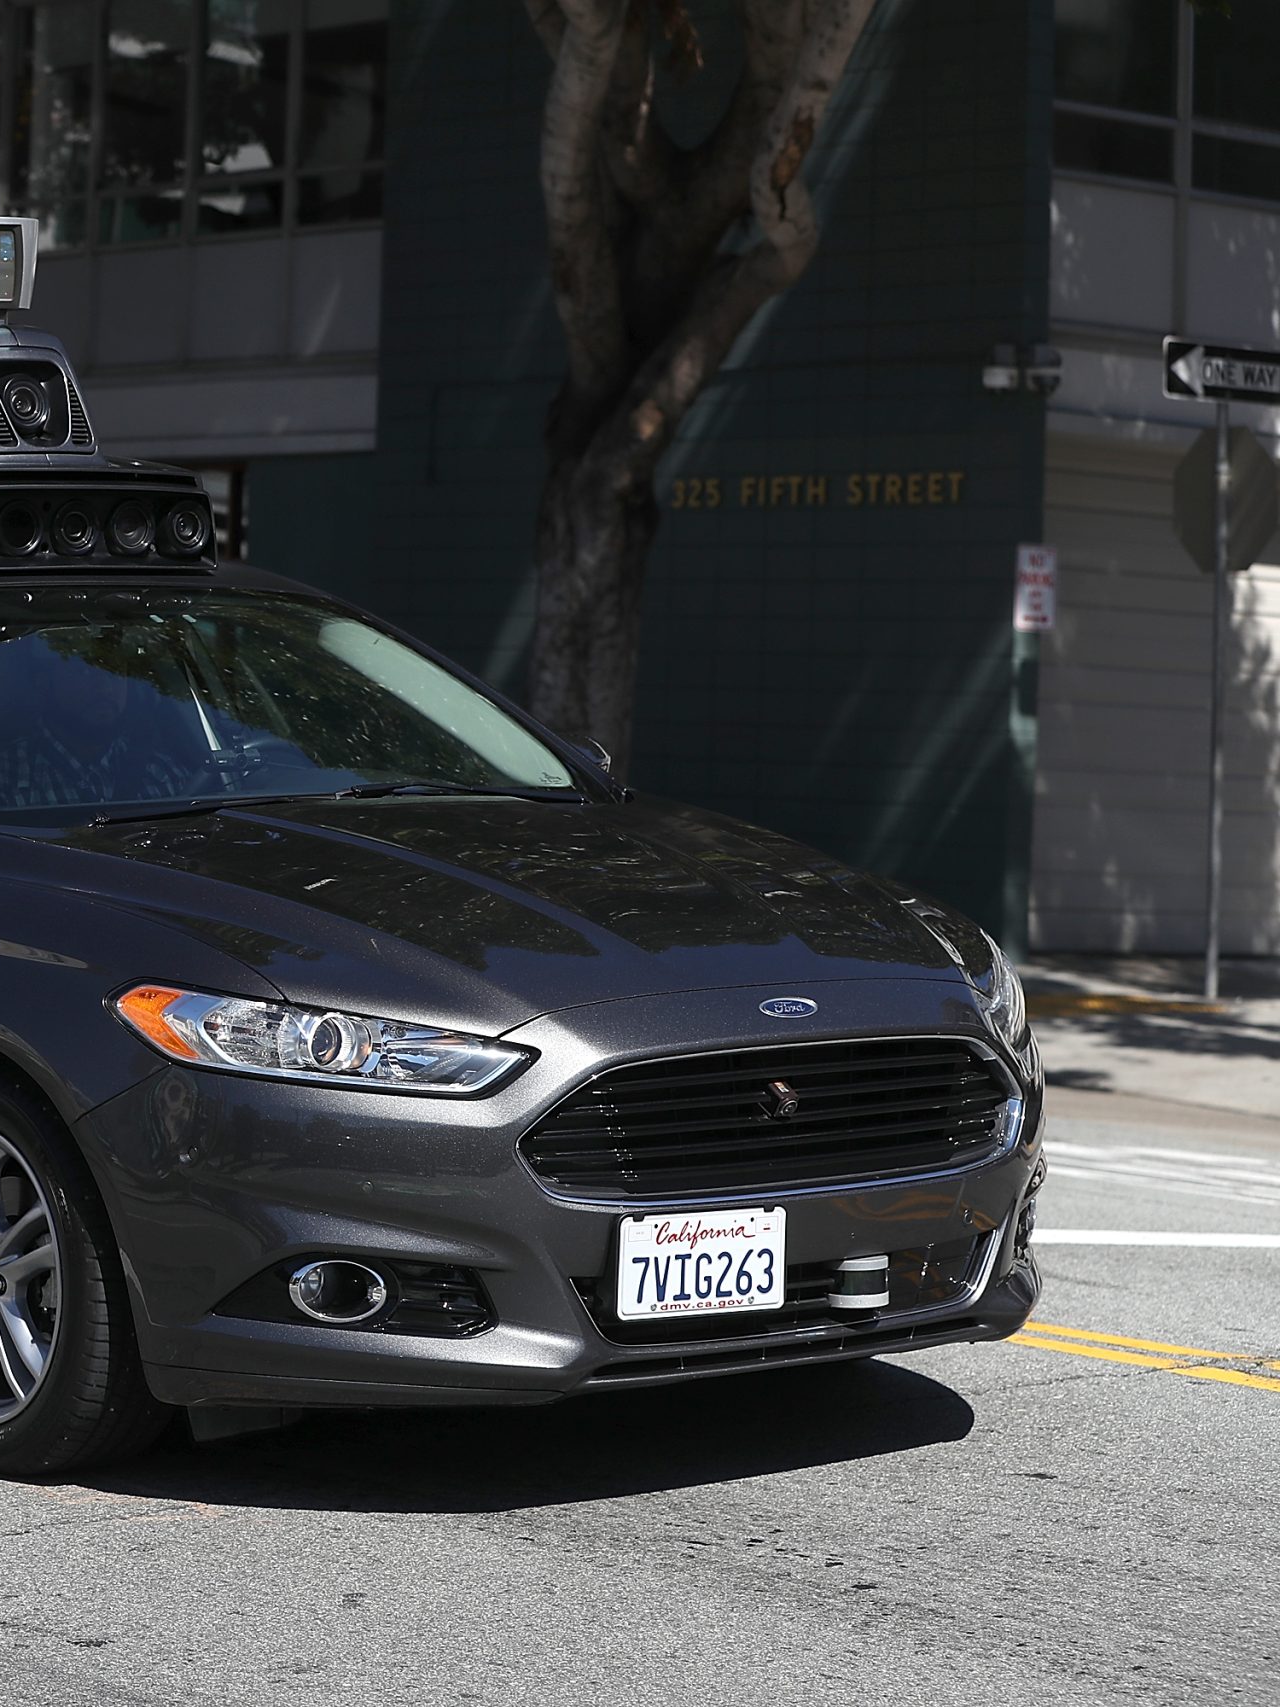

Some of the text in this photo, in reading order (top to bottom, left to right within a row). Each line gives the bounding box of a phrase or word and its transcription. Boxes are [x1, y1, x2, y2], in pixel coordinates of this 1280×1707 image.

[1202, 358, 1276, 388] ONE WAY
[671, 472, 964, 509] 325 FIFTH STREET
[656, 1219, 756, 1250] California
[632, 1248, 774, 1304] 7VIG263
[660, 1298, 744, 1312] dmv.ca.gov
